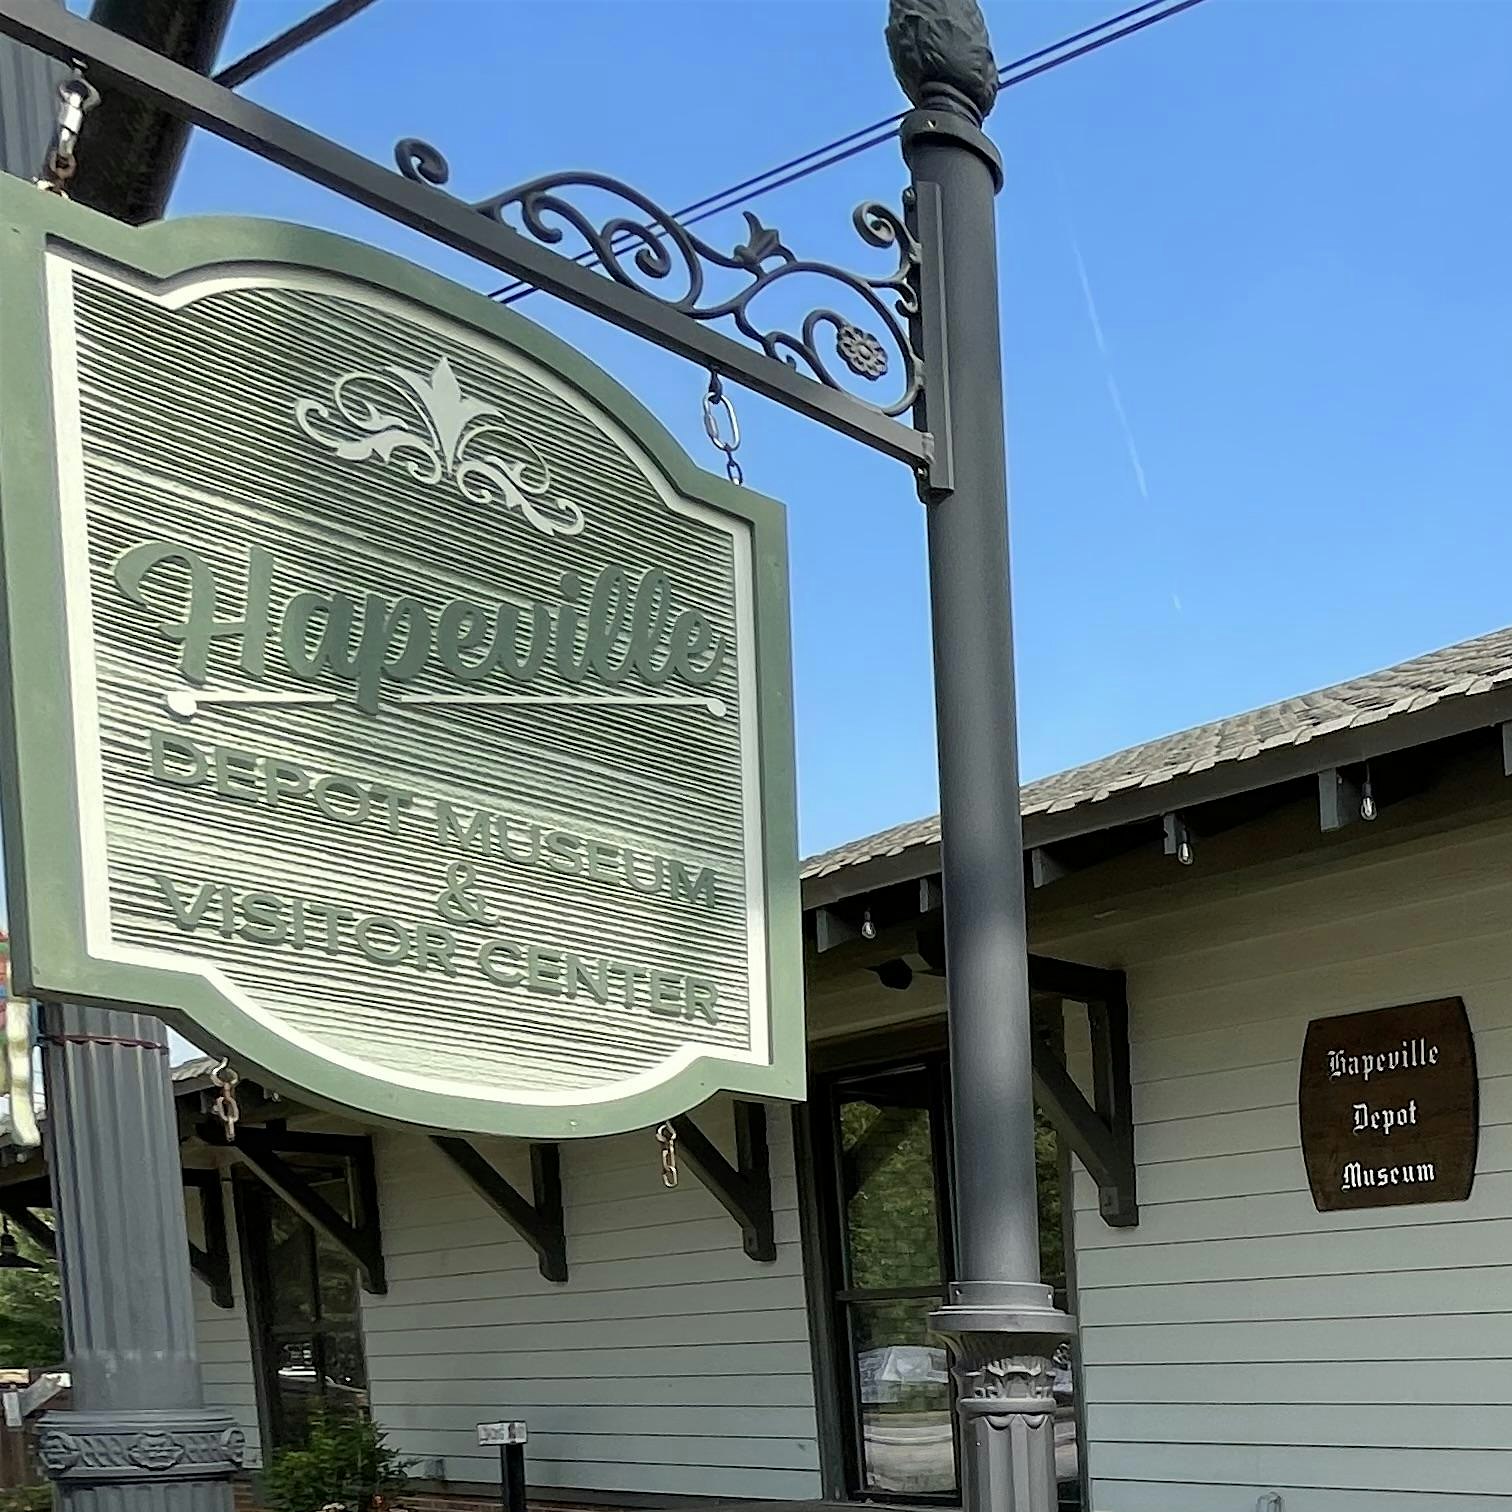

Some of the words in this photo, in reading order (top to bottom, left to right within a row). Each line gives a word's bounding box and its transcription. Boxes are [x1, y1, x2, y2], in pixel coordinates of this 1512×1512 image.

[114, 541, 726, 716] Hapeville
[148, 728, 412, 836] DEPOT
[435, 799, 718, 909] MUSEUM
[437, 860, 500, 928] &
[153, 874, 458, 977] VISITOR
[476, 939, 720, 1026] CENTER
[1327, 1037, 1439, 1081] Hapeville
[1352, 1100, 1417, 1136] Depot
[1341, 1162, 1436, 1193] Museum
